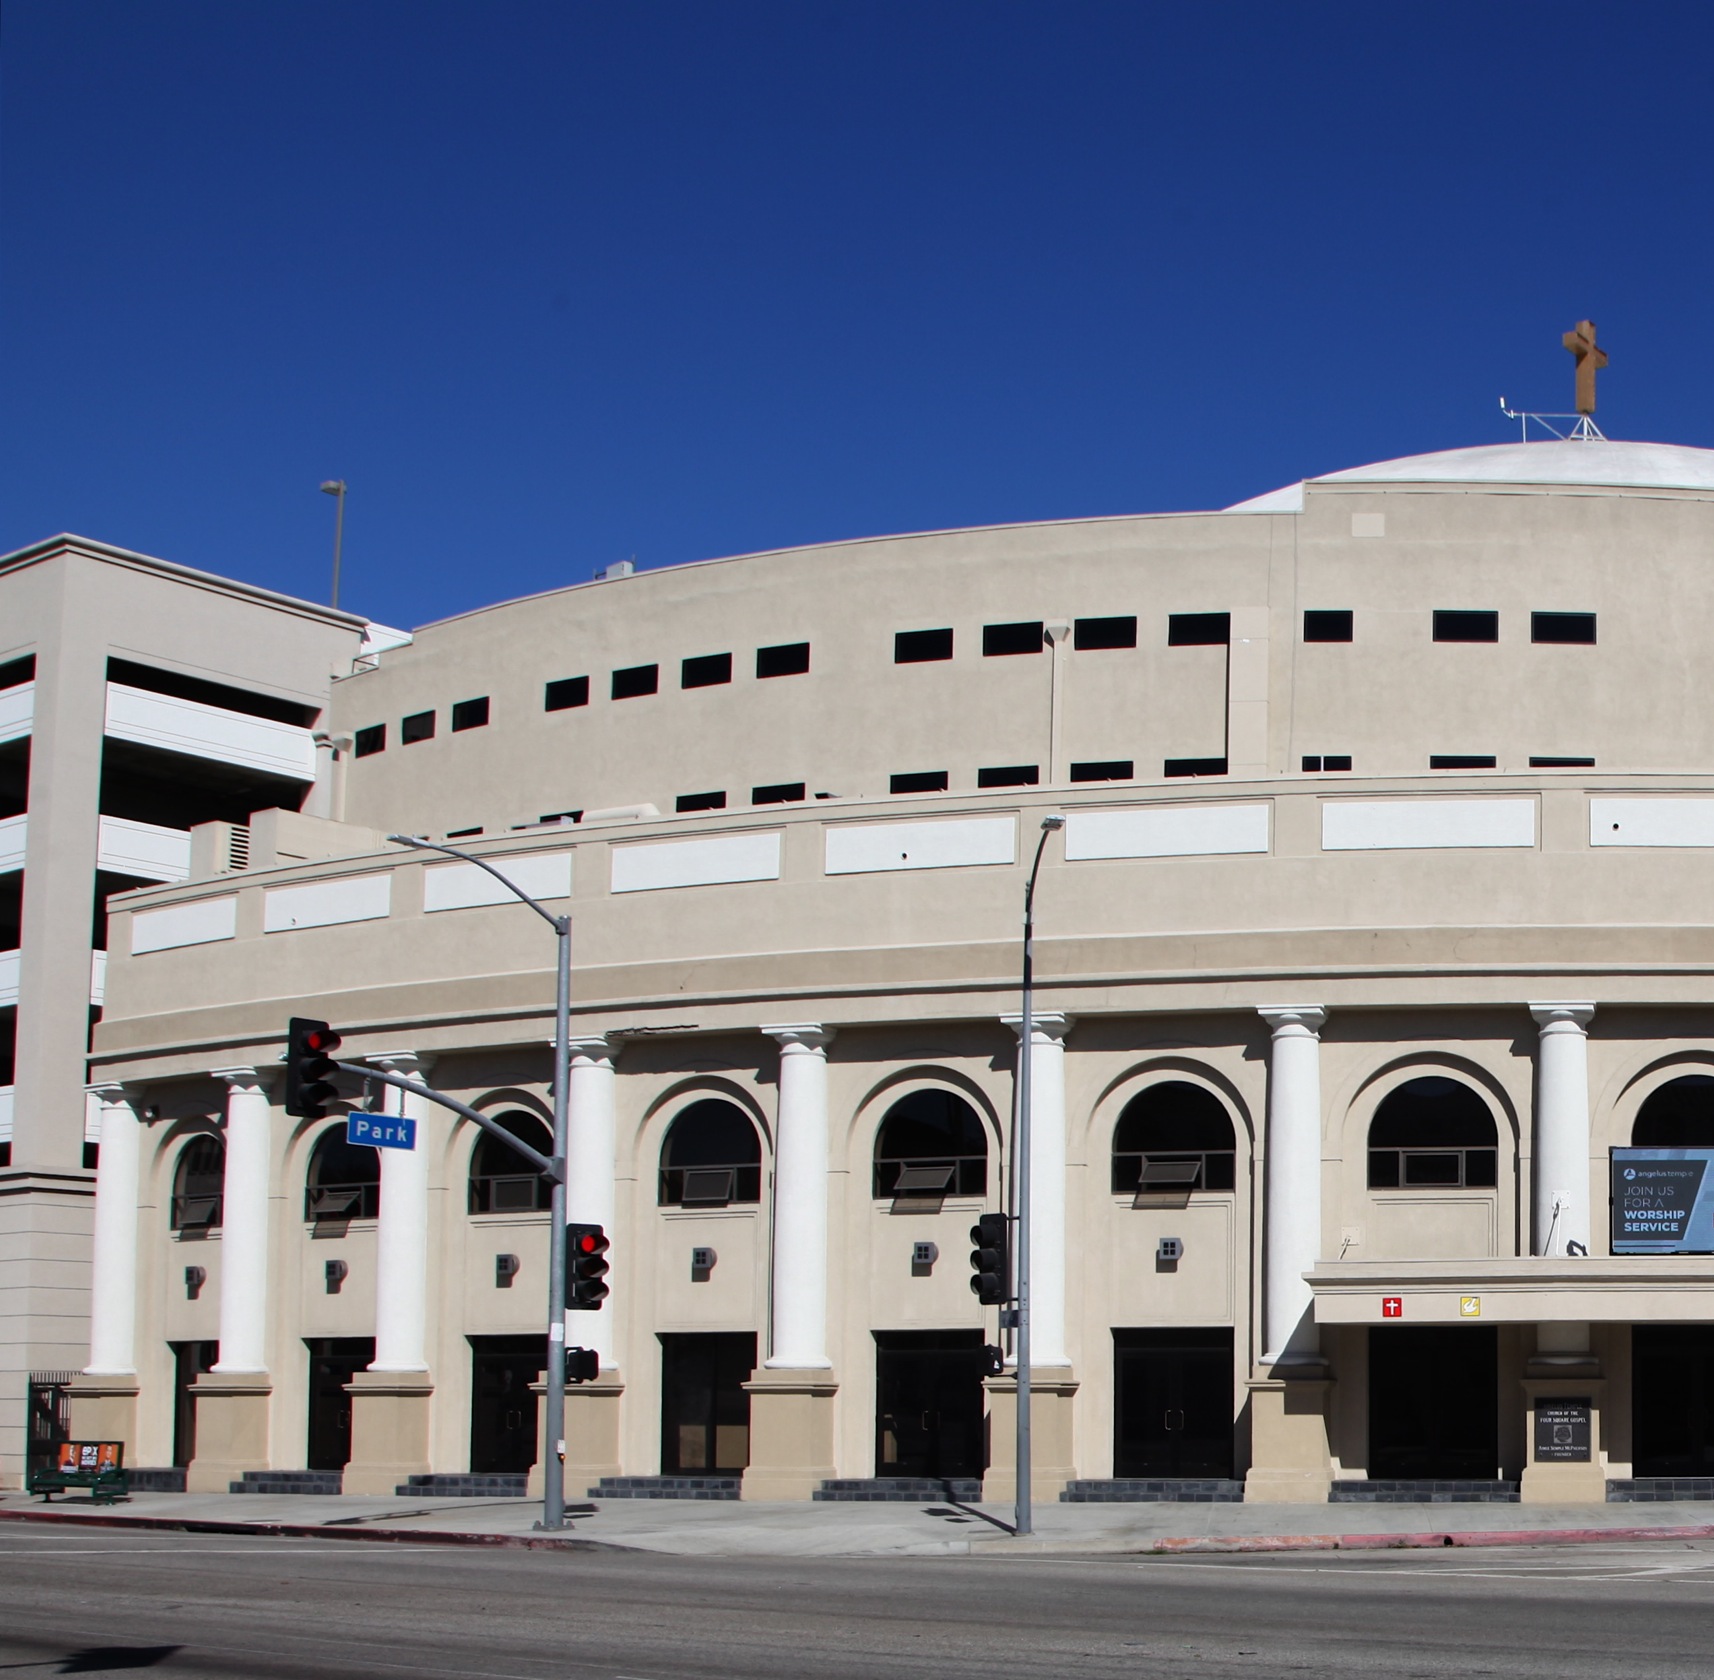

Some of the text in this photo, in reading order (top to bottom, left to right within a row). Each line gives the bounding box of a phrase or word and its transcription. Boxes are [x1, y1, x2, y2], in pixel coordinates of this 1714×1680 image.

[356, 1120, 407, 1142] Park
[1637, 1170, 1694, 1179] angelus tempe
[1624, 1186, 1674, 1196] JOIN US
[1624, 1199, 1664, 1208] FOR A
[1624, 1210, 1686, 1220] WORSHIP
[1624, 1222, 1679, 1232] SERVICE
